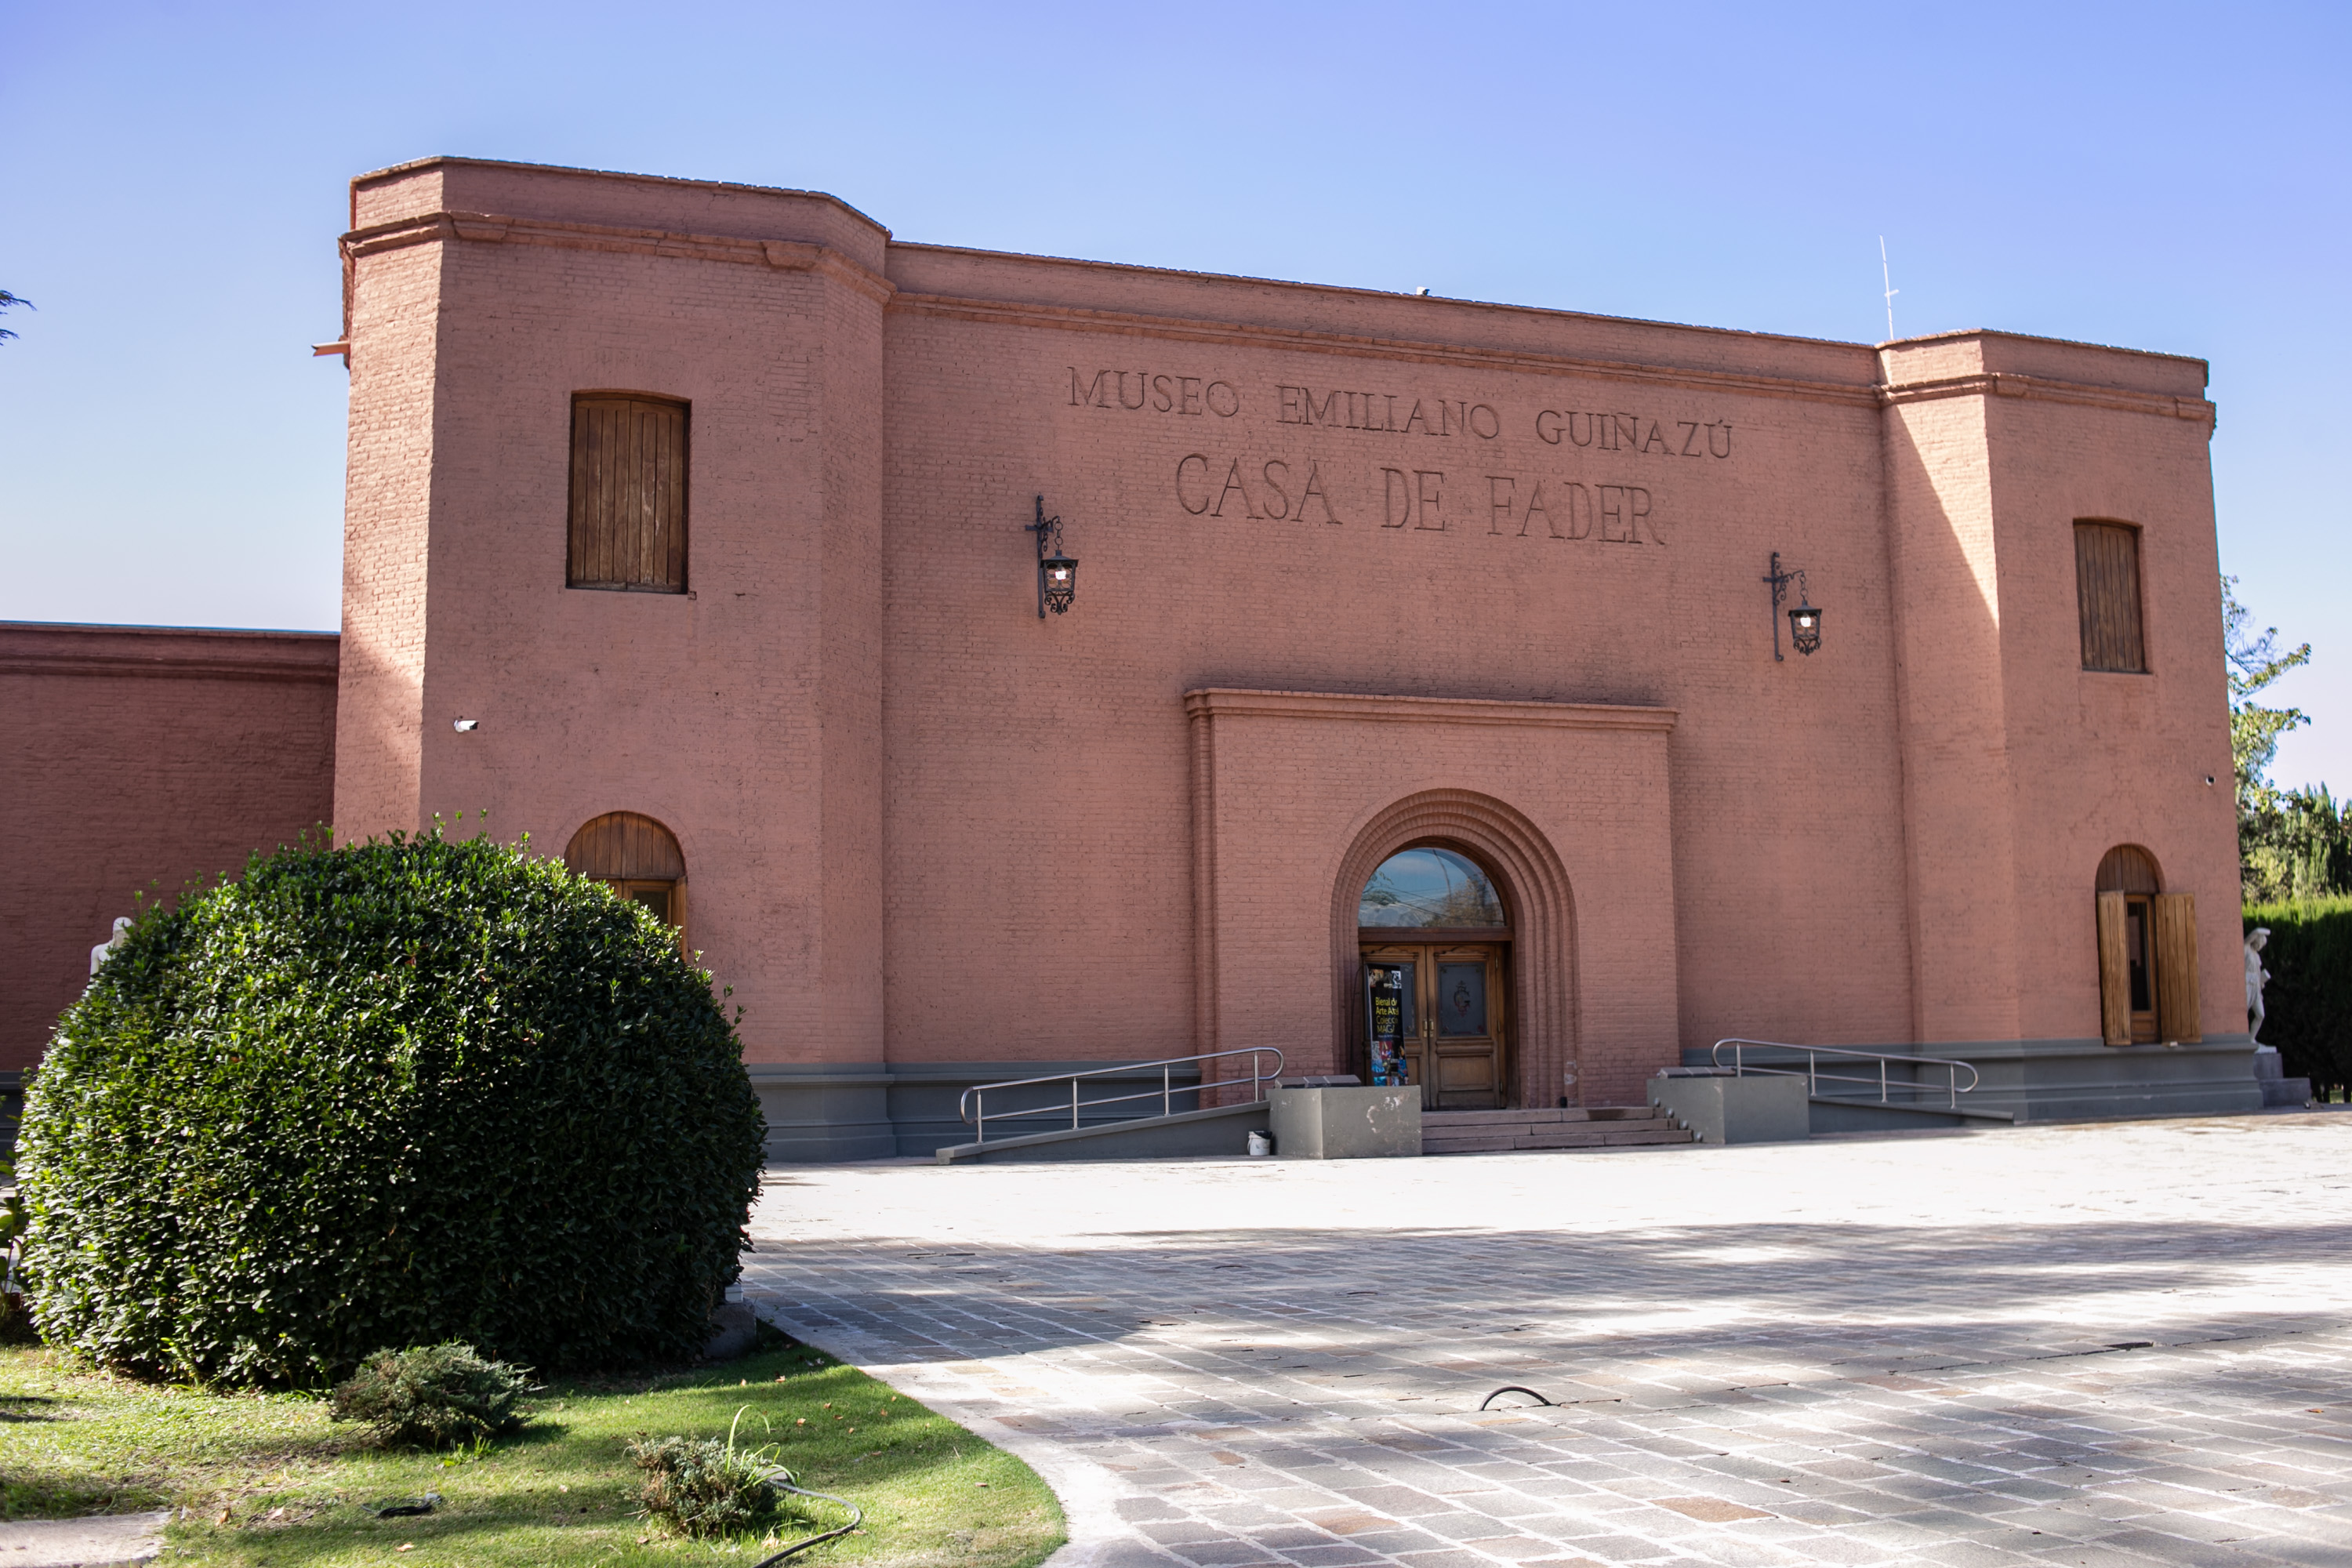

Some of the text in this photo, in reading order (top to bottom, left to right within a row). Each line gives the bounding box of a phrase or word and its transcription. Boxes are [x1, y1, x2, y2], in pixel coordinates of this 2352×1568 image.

[1067, 366, 1733, 459] MUSEO EMILIANO GUIÑAZÚ
[1177, 452, 1665, 545] CASA DE FADER
[1375, 996, 1391, 1007] Bienal
[1375, 1006, 1387, 1015] Arte
